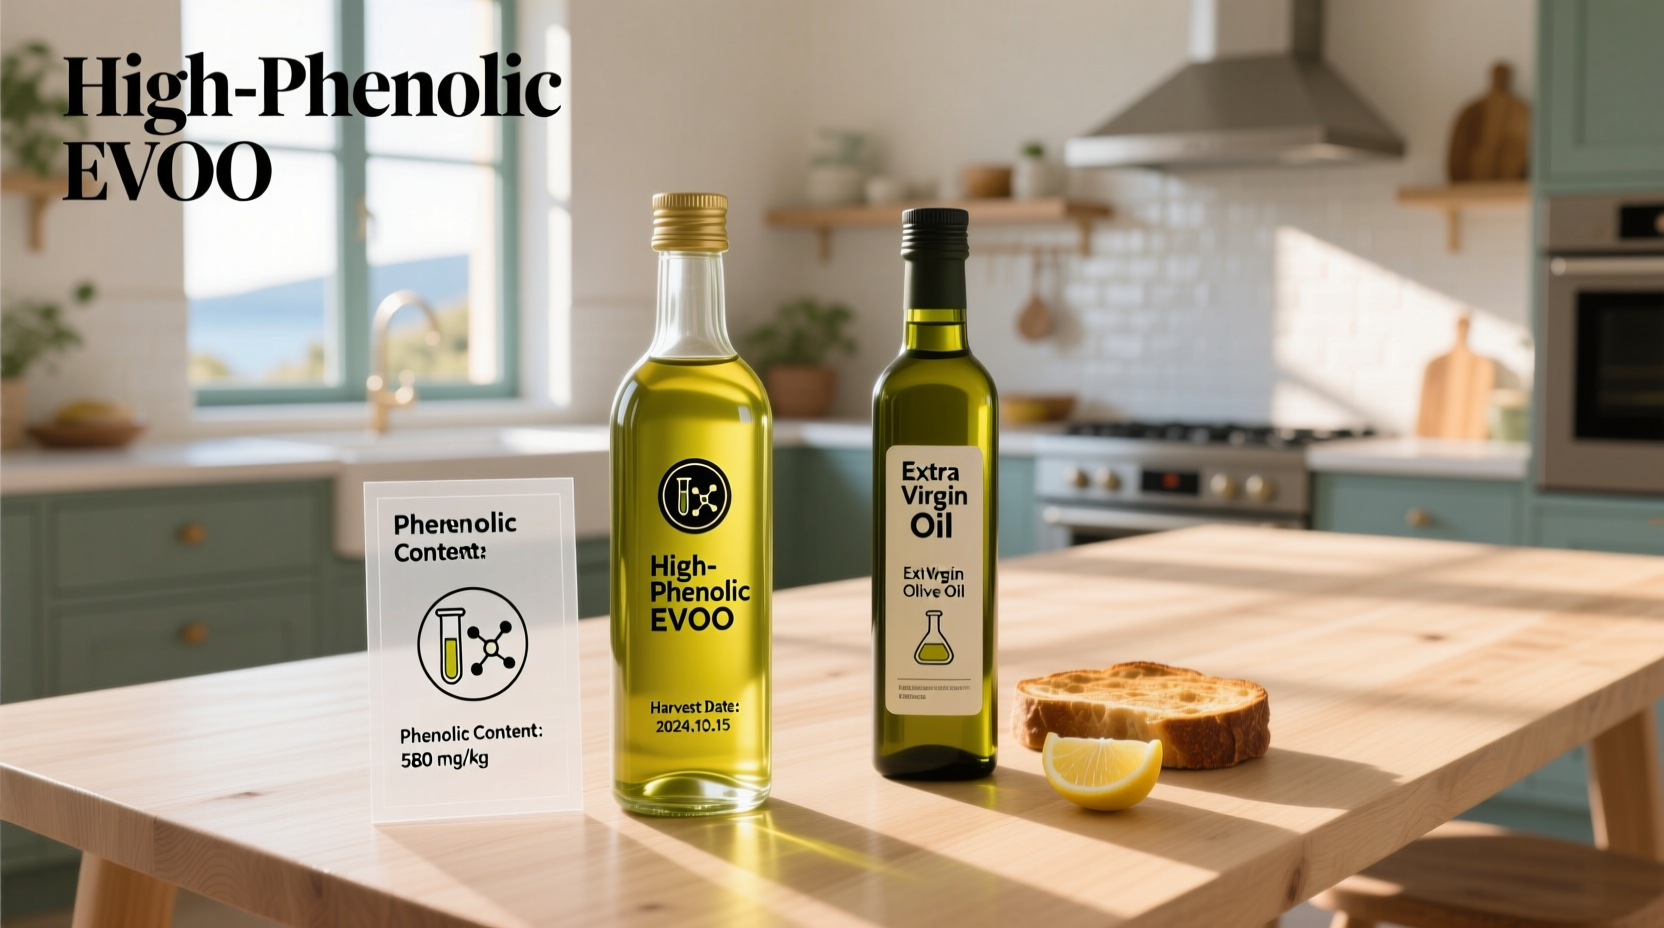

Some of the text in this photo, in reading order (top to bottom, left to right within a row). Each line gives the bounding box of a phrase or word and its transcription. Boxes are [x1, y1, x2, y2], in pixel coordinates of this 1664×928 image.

[902, 461, 959, 481] Extra
[901, 485, 968, 511] Virgin
[910, 512, 952, 538] Oil
[651, 554, 717, 582] High-
[650, 579, 751, 602] Phenolic
[903, 583, 965, 598] Olive Oil
[651, 606, 734, 632] EVOO
[650, 700, 740, 714] Harvest Date:
[400, 723, 543, 744] Phenolic Content:
[656, 718, 731, 733] 2024.10.15
[401, 748, 489, 770] 580 mg/kg
